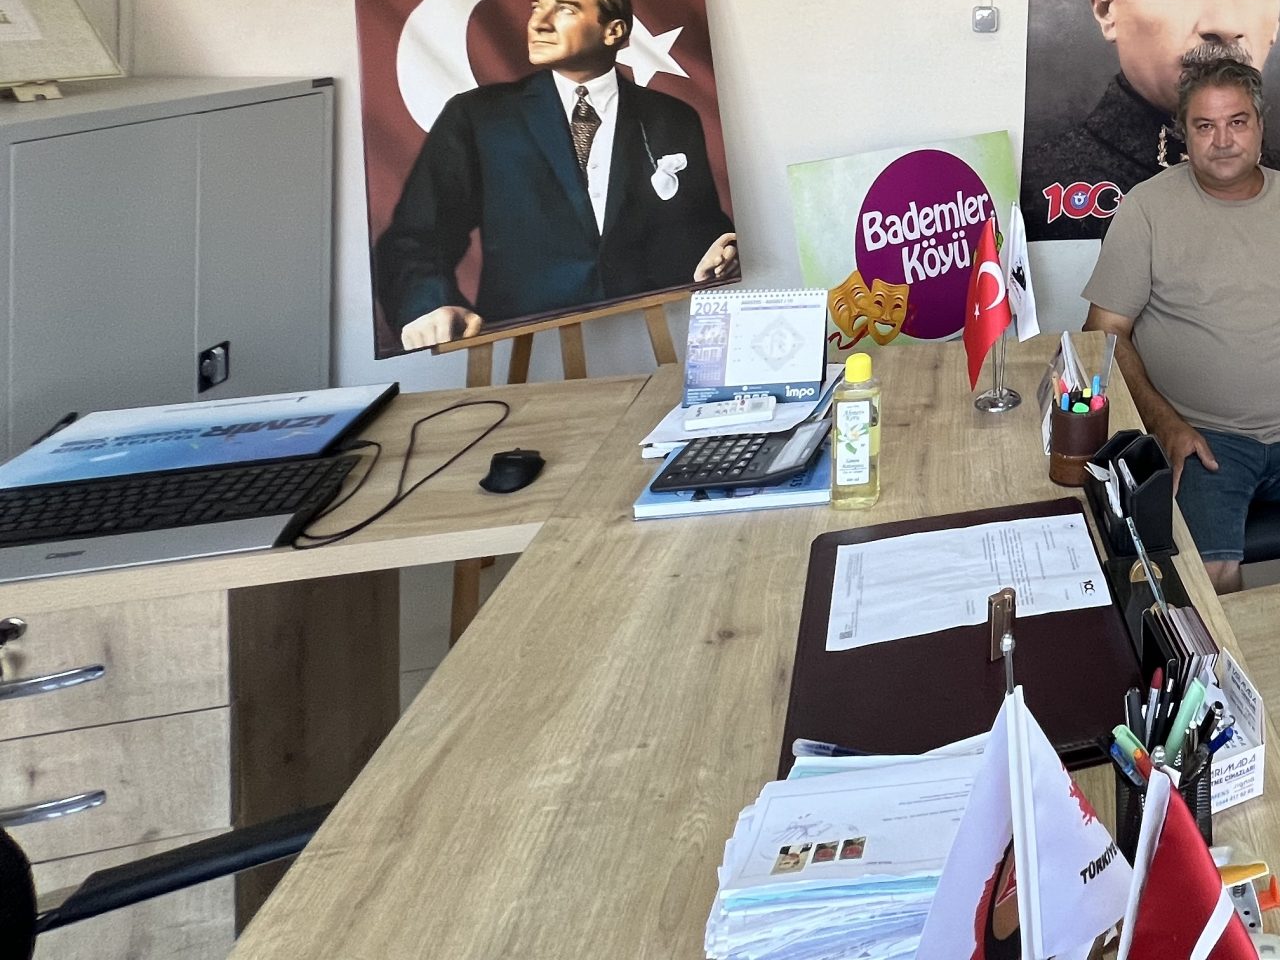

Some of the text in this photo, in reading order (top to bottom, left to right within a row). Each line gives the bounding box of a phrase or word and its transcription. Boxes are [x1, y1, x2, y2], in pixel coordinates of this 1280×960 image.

[862, 190, 989, 252] Bademler
[902, 230, 971, 285] Köyü
[694, 301, 729, 316] 2024
[785, 385, 815, 399] impo
[1211, 753, 1256, 779] RIMADA
[1211, 778, 1223, 786] TME
